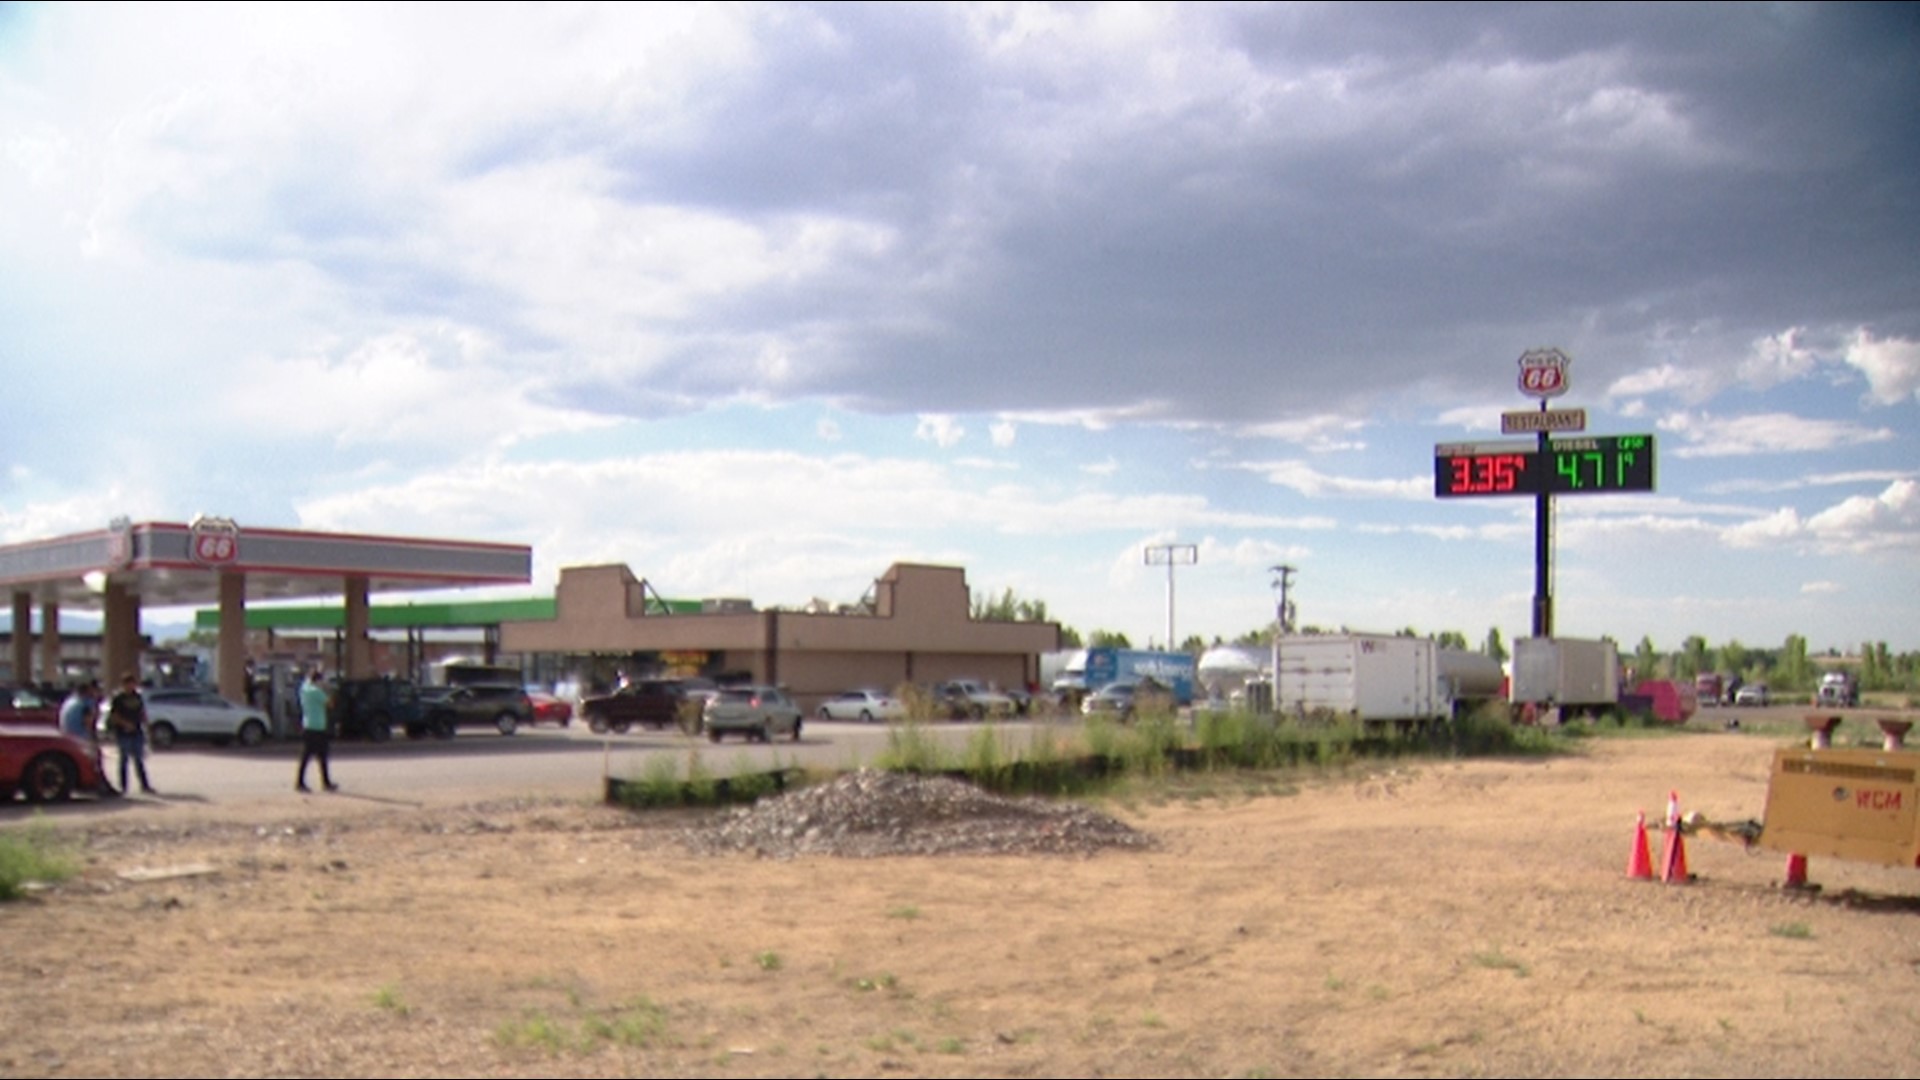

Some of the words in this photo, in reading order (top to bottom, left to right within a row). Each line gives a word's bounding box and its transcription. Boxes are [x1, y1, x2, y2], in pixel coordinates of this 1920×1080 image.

[1527, 369, 1556, 389] 66
[1507, 412, 1580, 430] RESTAURANT
[201, 538, 231, 558] 66
